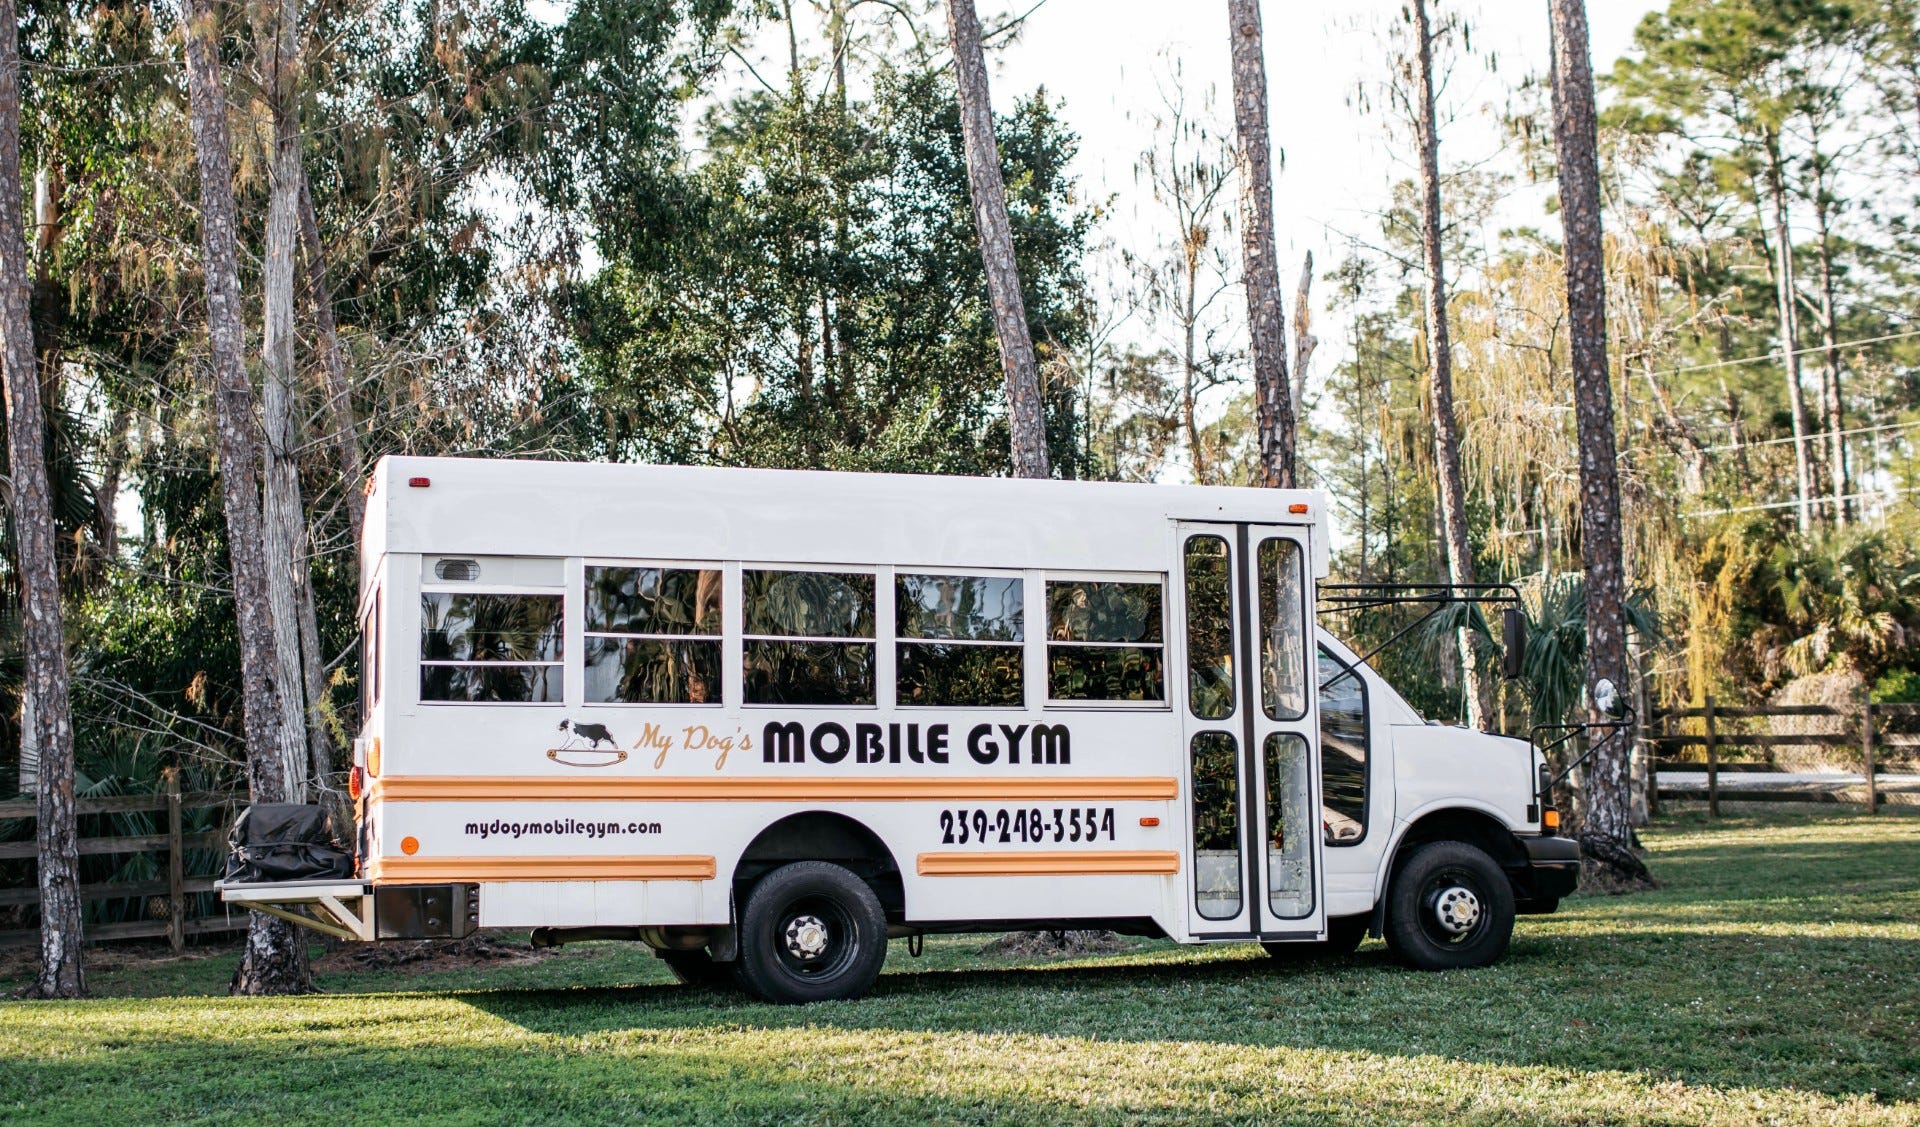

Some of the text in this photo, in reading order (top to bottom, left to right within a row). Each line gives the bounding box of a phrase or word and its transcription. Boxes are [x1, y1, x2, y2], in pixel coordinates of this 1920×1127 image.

[633, 721, 1071, 771] My Dog's MOBILE GYM
[465, 818, 662, 839] mydogsmobilegym.com
[939, 807, 1116, 845] 239-248-3554
